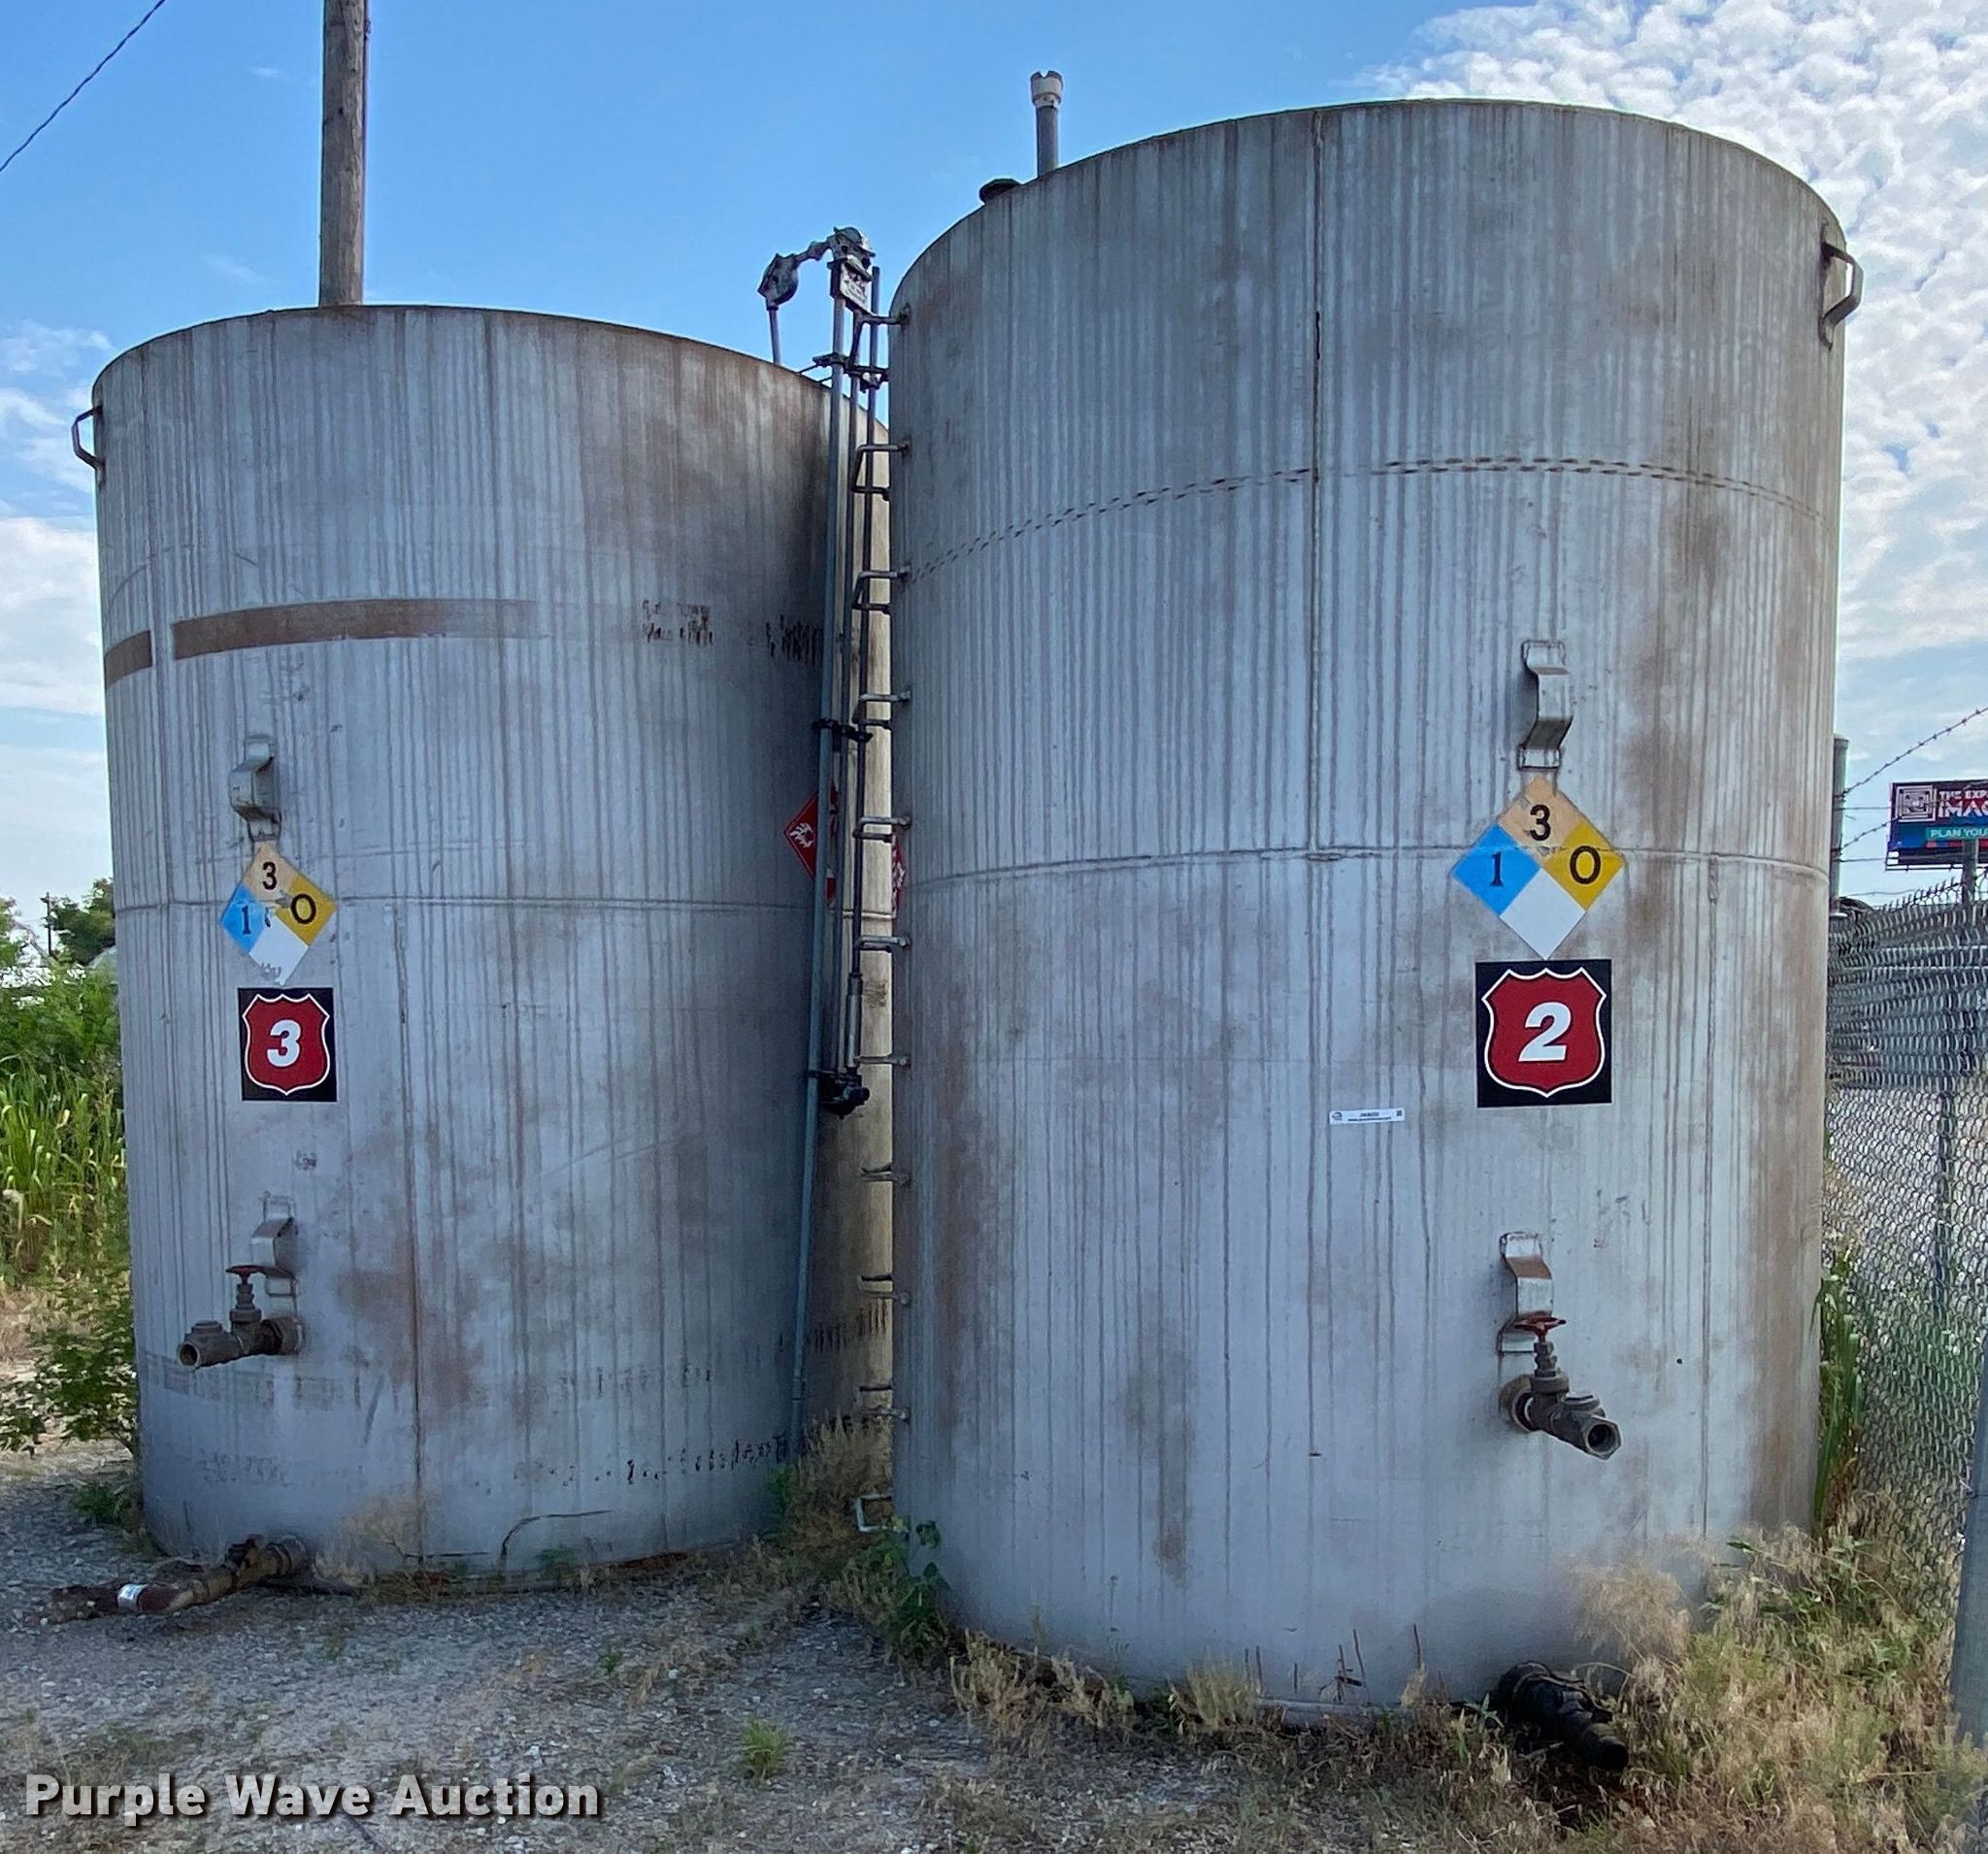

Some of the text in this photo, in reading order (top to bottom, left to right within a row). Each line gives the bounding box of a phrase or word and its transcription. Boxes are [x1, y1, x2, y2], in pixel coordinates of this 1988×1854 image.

[1965, 789, 1988, 799] EXP
[1529, 805, 1551, 841] 3
[1931, 829, 1961, 838] PLAN
[262, 861, 278, 890] 3
[1490, 851, 1504, 887] 1
[241, 905, 251, 935] 1
[267, 1019, 301, 1067] 3
[1518, 1001, 1572, 1062] 2
